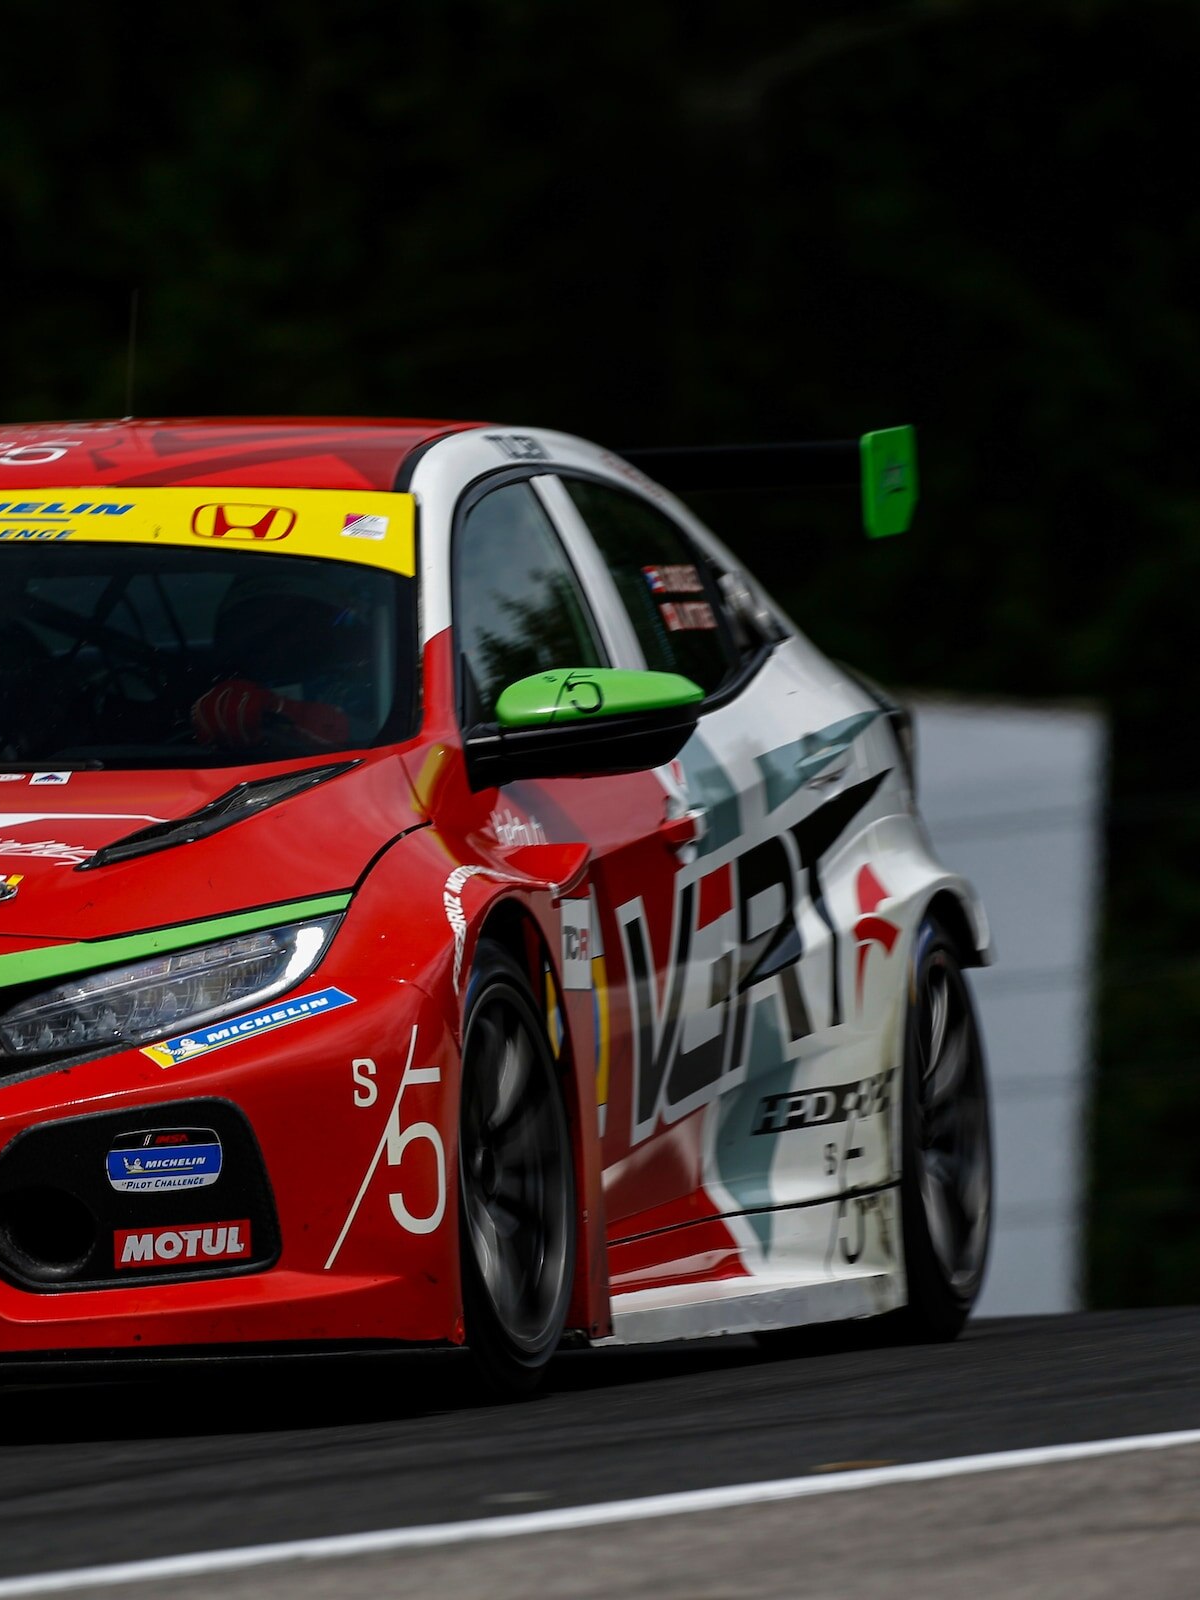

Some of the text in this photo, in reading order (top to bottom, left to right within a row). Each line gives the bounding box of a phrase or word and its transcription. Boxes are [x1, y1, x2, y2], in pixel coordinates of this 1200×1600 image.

[206, 996, 329, 1044] MICHELIN
[154, 1132, 190, 1145] IMSA
[145, 1156, 207, 1169] MICHELIN
[126, 1180, 153, 1190] PILOT
[154, 1176, 205, 1189] CHALLENGE
[121, 1226, 245, 1263] MOTUL
